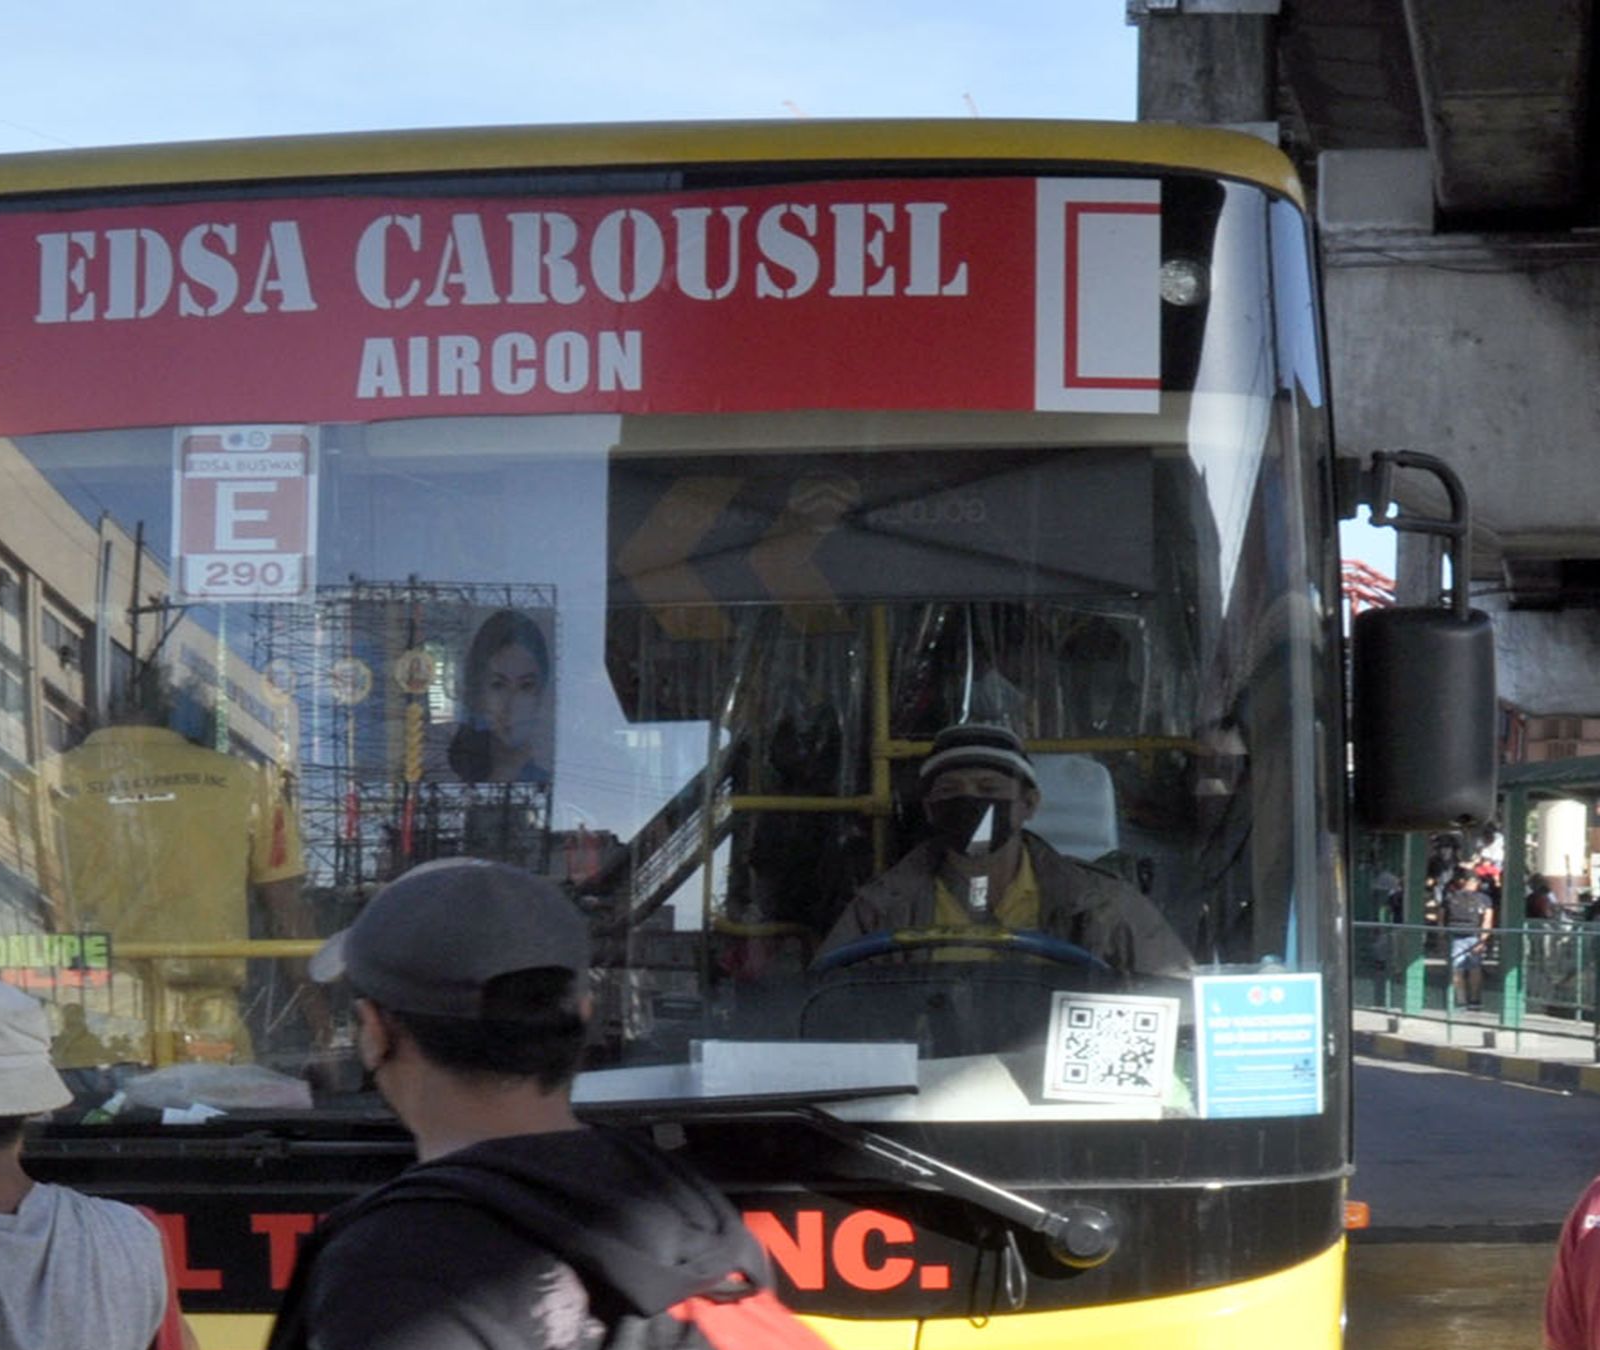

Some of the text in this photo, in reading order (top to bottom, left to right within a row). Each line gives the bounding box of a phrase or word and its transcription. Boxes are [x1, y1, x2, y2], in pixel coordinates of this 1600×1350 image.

[35, 203, 968, 324] EDSA CAROUSEL
[356, 329, 643, 399] AIRCON
[215, 480, 278, 551] E
[204, 561, 285, 587] 290
[742, 1209, 950, 1291] NC.
